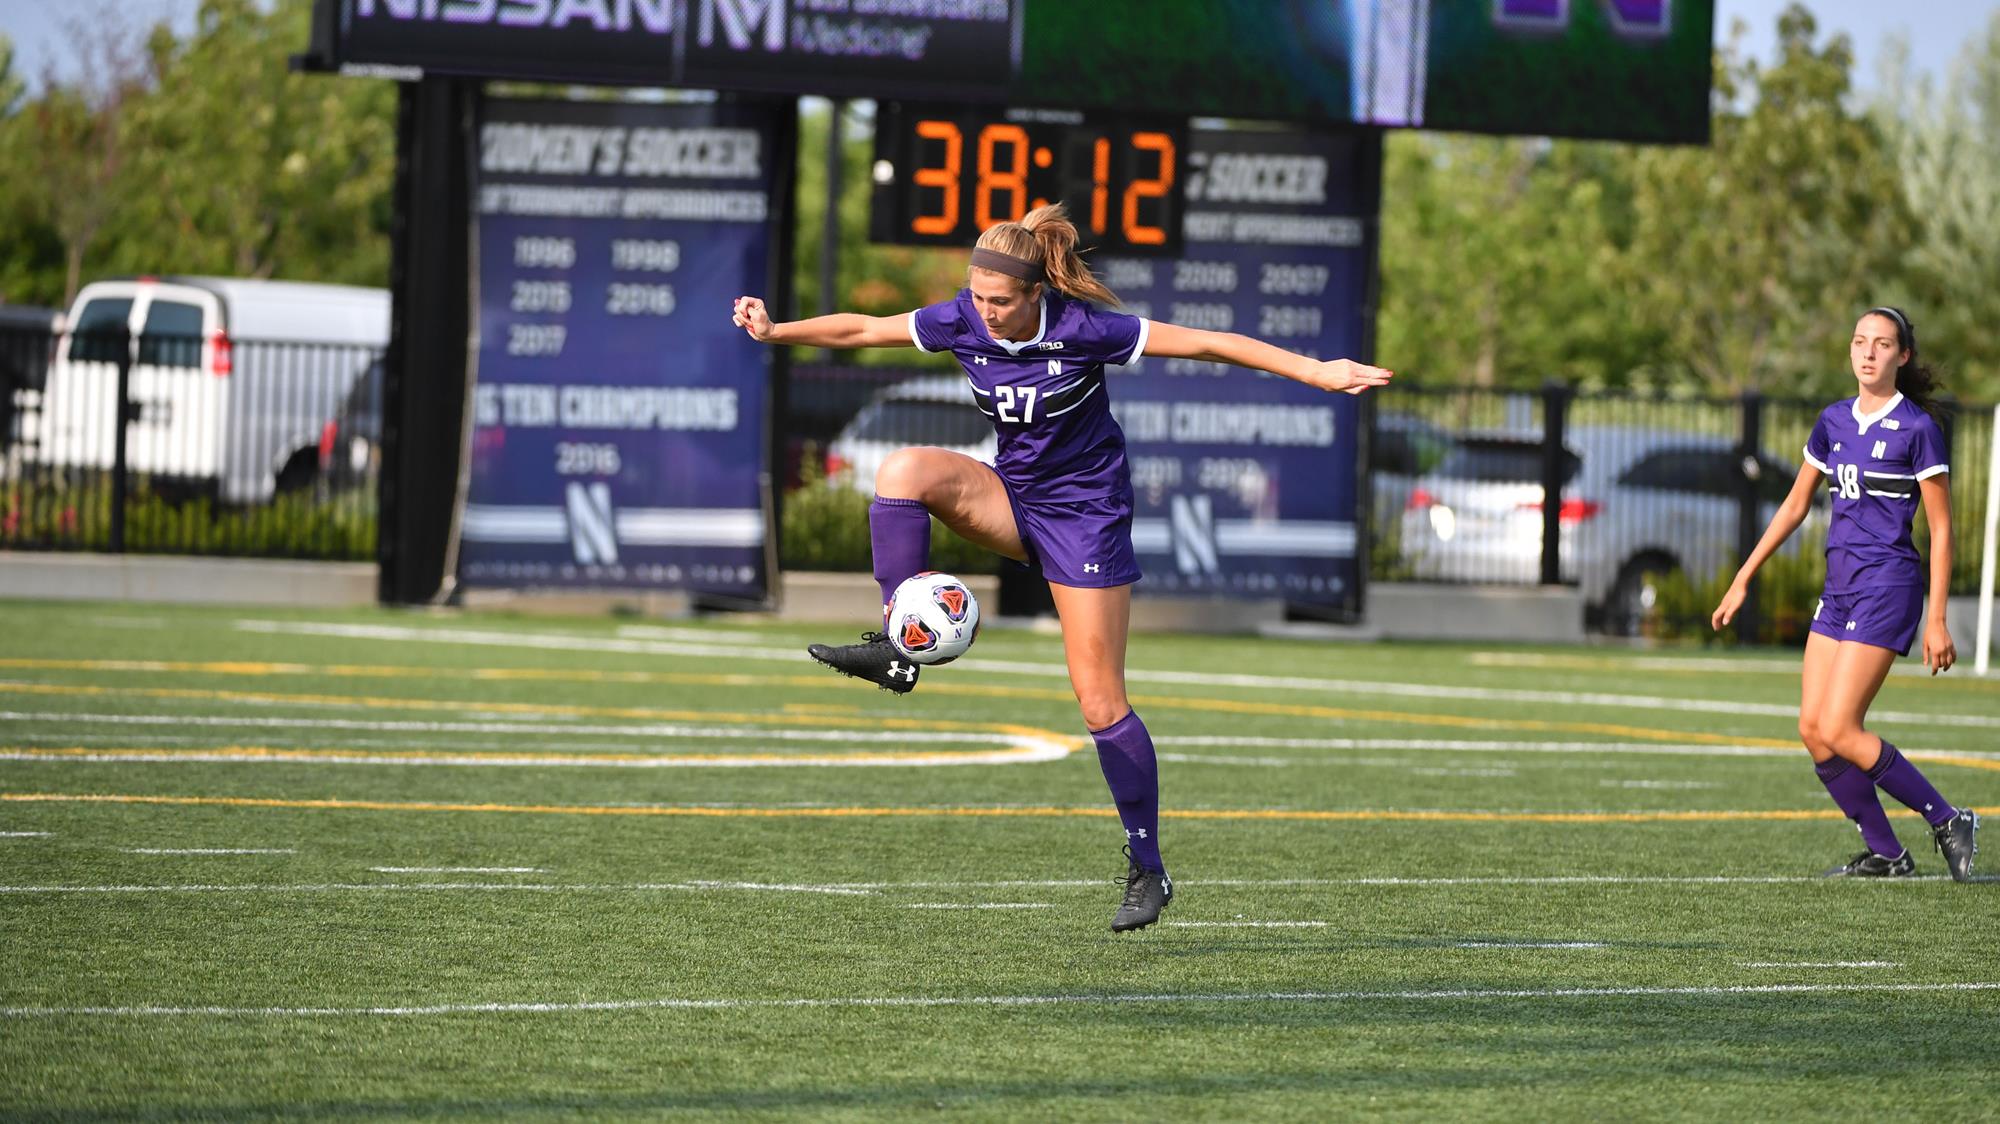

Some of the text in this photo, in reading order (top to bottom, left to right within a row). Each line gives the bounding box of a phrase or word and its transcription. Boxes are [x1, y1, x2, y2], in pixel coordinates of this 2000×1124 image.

[624, 127, 761, 178] SOCCER
[911, 120, 1177, 245] 38:12
[1207, 153, 1327, 204] SOCCER
[513, 236, 680, 273] 1996 1998
[1048, 360, 1062, 375] N
[504, 384, 557, 427] TEN
[559, 385, 738, 431] CHAMPIONS
[995, 385, 1037, 424] 27
[1171, 402, 1335, 447] CHAMPIONS
[1871, 440, 1887, 460] N
[1836, 464, 1861, 500] 18
[565, 482, 618, 565] N
[1171, 494, 1219, 575] N
[954, 628, 963, 639] N
